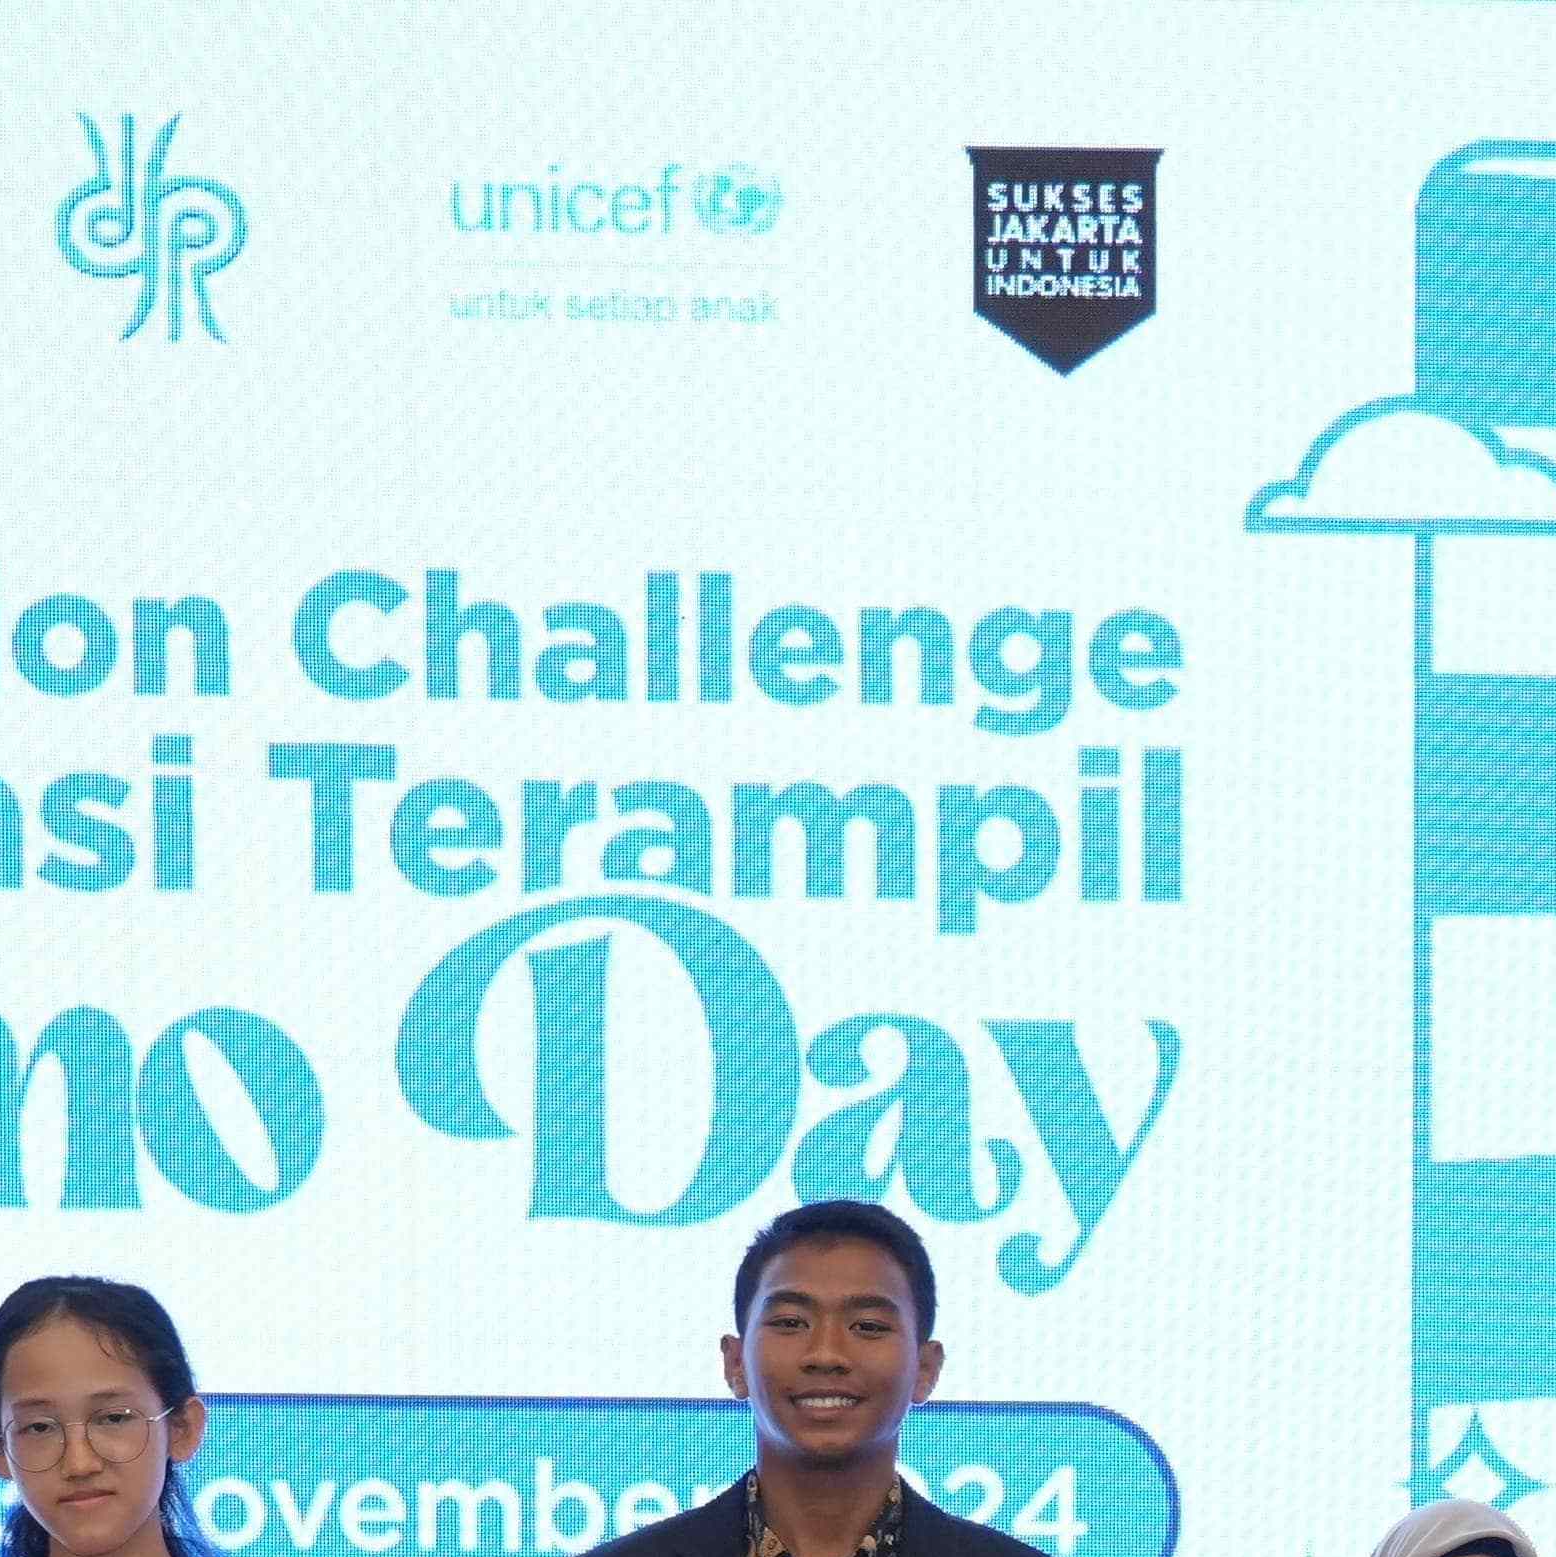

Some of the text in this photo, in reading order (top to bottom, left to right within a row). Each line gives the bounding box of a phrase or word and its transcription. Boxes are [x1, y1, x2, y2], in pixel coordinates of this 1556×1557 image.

[450, 160, 685, 234] unicef
[987, 183, 1143, 213] SUKSES
[987, 214, 1143, 244] JAKARTA
[986, 248, 1142, 274] UNTUK
[986, 274, 1142, 297] INDONESIA
[294, 571, 1182, 735] Challenge
[268, 743, 1182, 934] Terampil
[397, 894, 1182, 1296] Day
[894, 1463, 1091, 1556] 24
